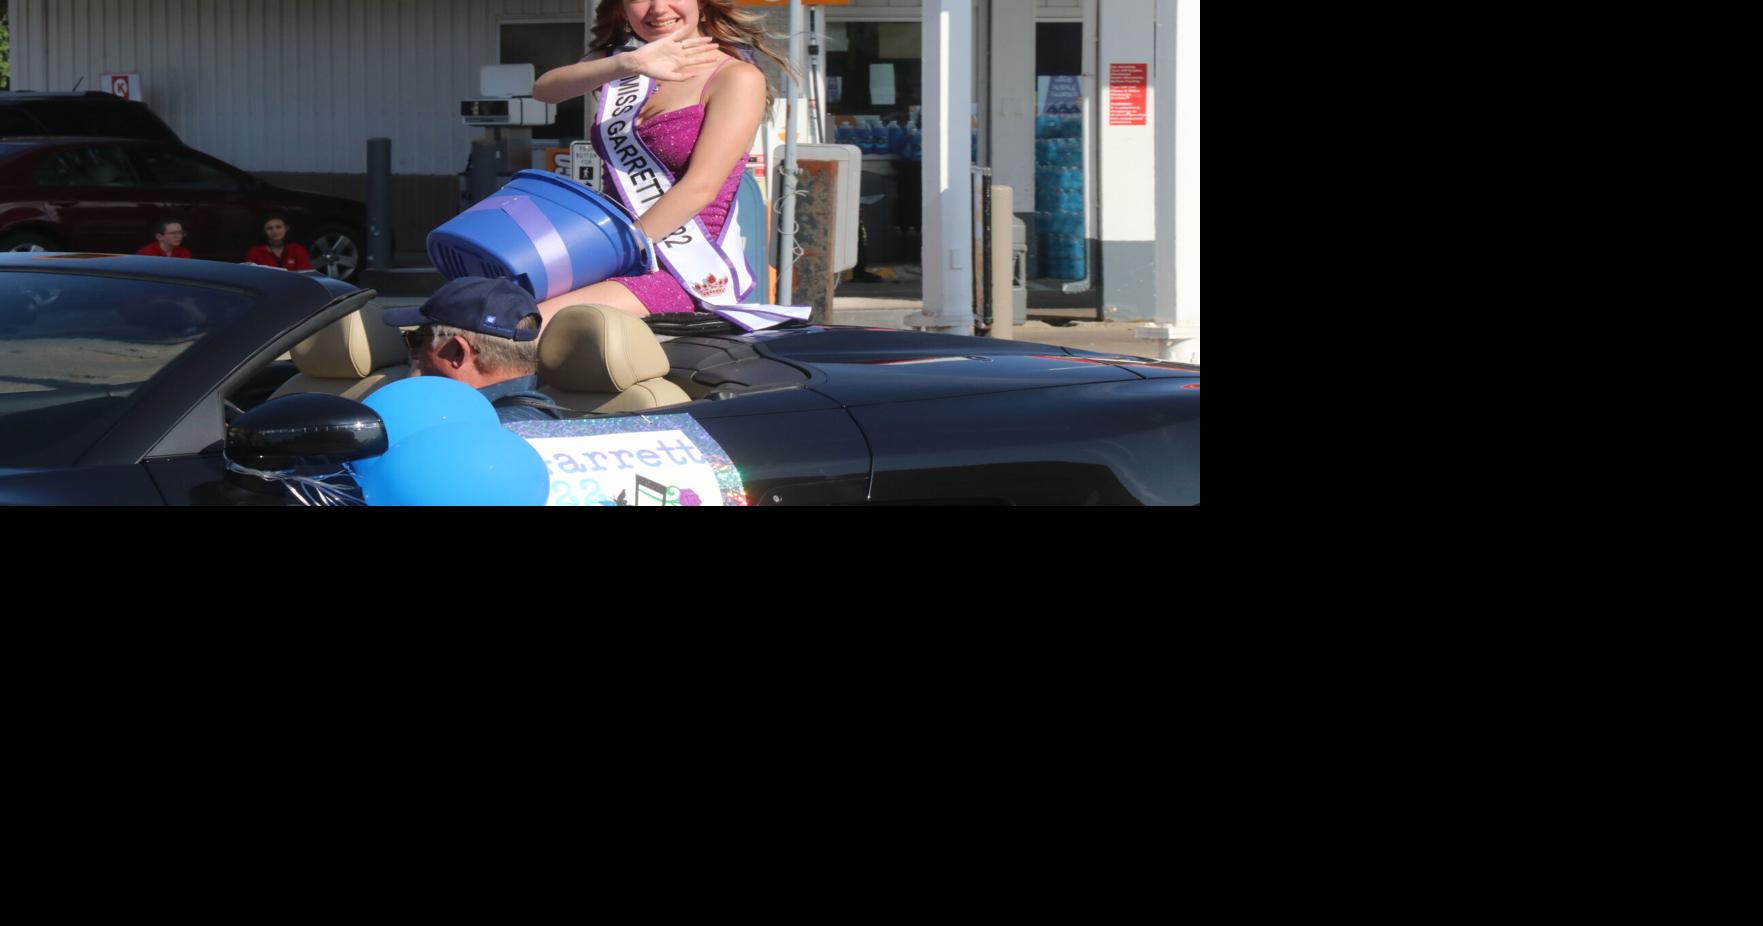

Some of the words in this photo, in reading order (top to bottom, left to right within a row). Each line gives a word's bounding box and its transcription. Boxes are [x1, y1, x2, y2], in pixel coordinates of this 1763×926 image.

[612, 74, 640, 117] MISS
[607, 121, 664, 203] GARRETT
[545, 439, 705, 474] arrett
